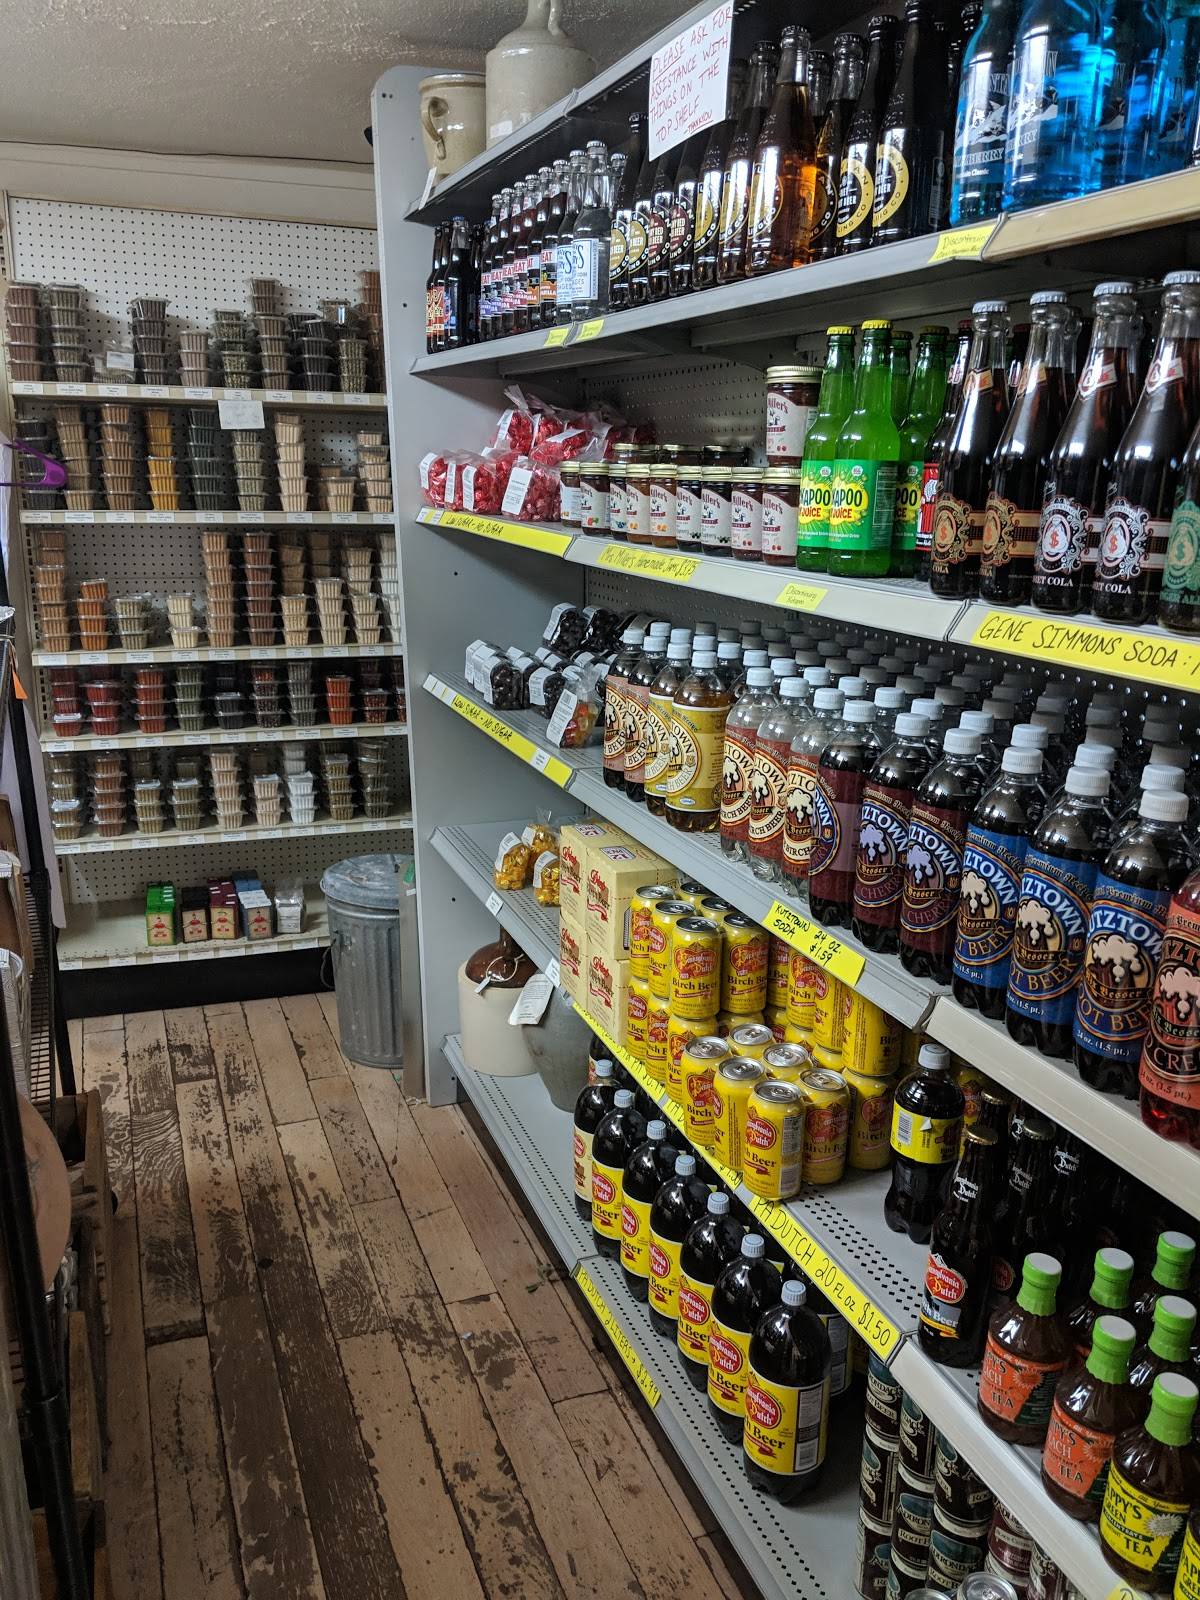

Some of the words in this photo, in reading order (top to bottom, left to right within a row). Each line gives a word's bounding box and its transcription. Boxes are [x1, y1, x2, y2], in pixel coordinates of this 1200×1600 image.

[652, 37, 685, 78] PLEASE
[690, 24, 708, 48] ASK
[713, 6, 733, 32] FOR
[703, 32, 728, 60] WITH
[650, 90, 677, 123] THINGS
[680, 82, 692, 100] ON
[698, 58, 720, 88] THE
[656, 117, 672, 143] TOP
[674, 95, 699, 131] SHELF
[1047, 576, 1074, 589] COLA
[1105, 582, 1132, 596] COLA
[979, 615, 1032, 643] GENE
[1032, 624, 1122, 656] SIMMONS
[453, 699, 464, 710] LOW
[465, 703, 480, 721] SUGAR
[482, 717, 492, 730] NO
[492, 722, 512, 743] SUGAR
[1106, 885, 1152, 911] Premium
[773, 918, 796, 940] SODA
[809, 942, 833, 967] $1.59
[814, 930, 828, 944] 24
[828, 940, 843, 956] OZ.
[967, 926, 1010, 957] BEER
[672, 976, 696, 991] Birch
[727, 975, 755, 988] Birch
[1028, 957, 1078, 992] BEER
[1100, 984, 1143, 999] Besser
[1113, 1047, 1130, 1057] pt.)
[1172, 1088, 1192, 1102] pt.)
[687, 1102, 712, 1118] Birch
[752, 1152, 778, 1170] Beer
[596, 1202, 620, 1221] Beer
[623, 1237, 644, 1256] Beer
[753, 1197, 776, 1222] PA
[770, 1209, 817, 1267] DUTCH
[815, 1258, 837, 1288] 20
[832, 1282, 846, 1300] FL
[844, 1296, 857, 1313] OZ
[857, 1301, 892, 1348] $1.50
[587, 1280, 606, 1315] DUTCH
[652, 1275, 675, 1297] Beer
[932, 1279, 958, 1302] Dutch
[931, 1307, 959, 1329] Beer
[717, 1374, 748, 1395] Beer
[990, 1389, 1014, 1411] TEA
[751, 1400, 775, 1425] Dutch
[753, 1424, 787, 1450] Beer
[1058, 1464, 1084, 1485] TEA
[1123, 1537, 1154, 1560] TEA
